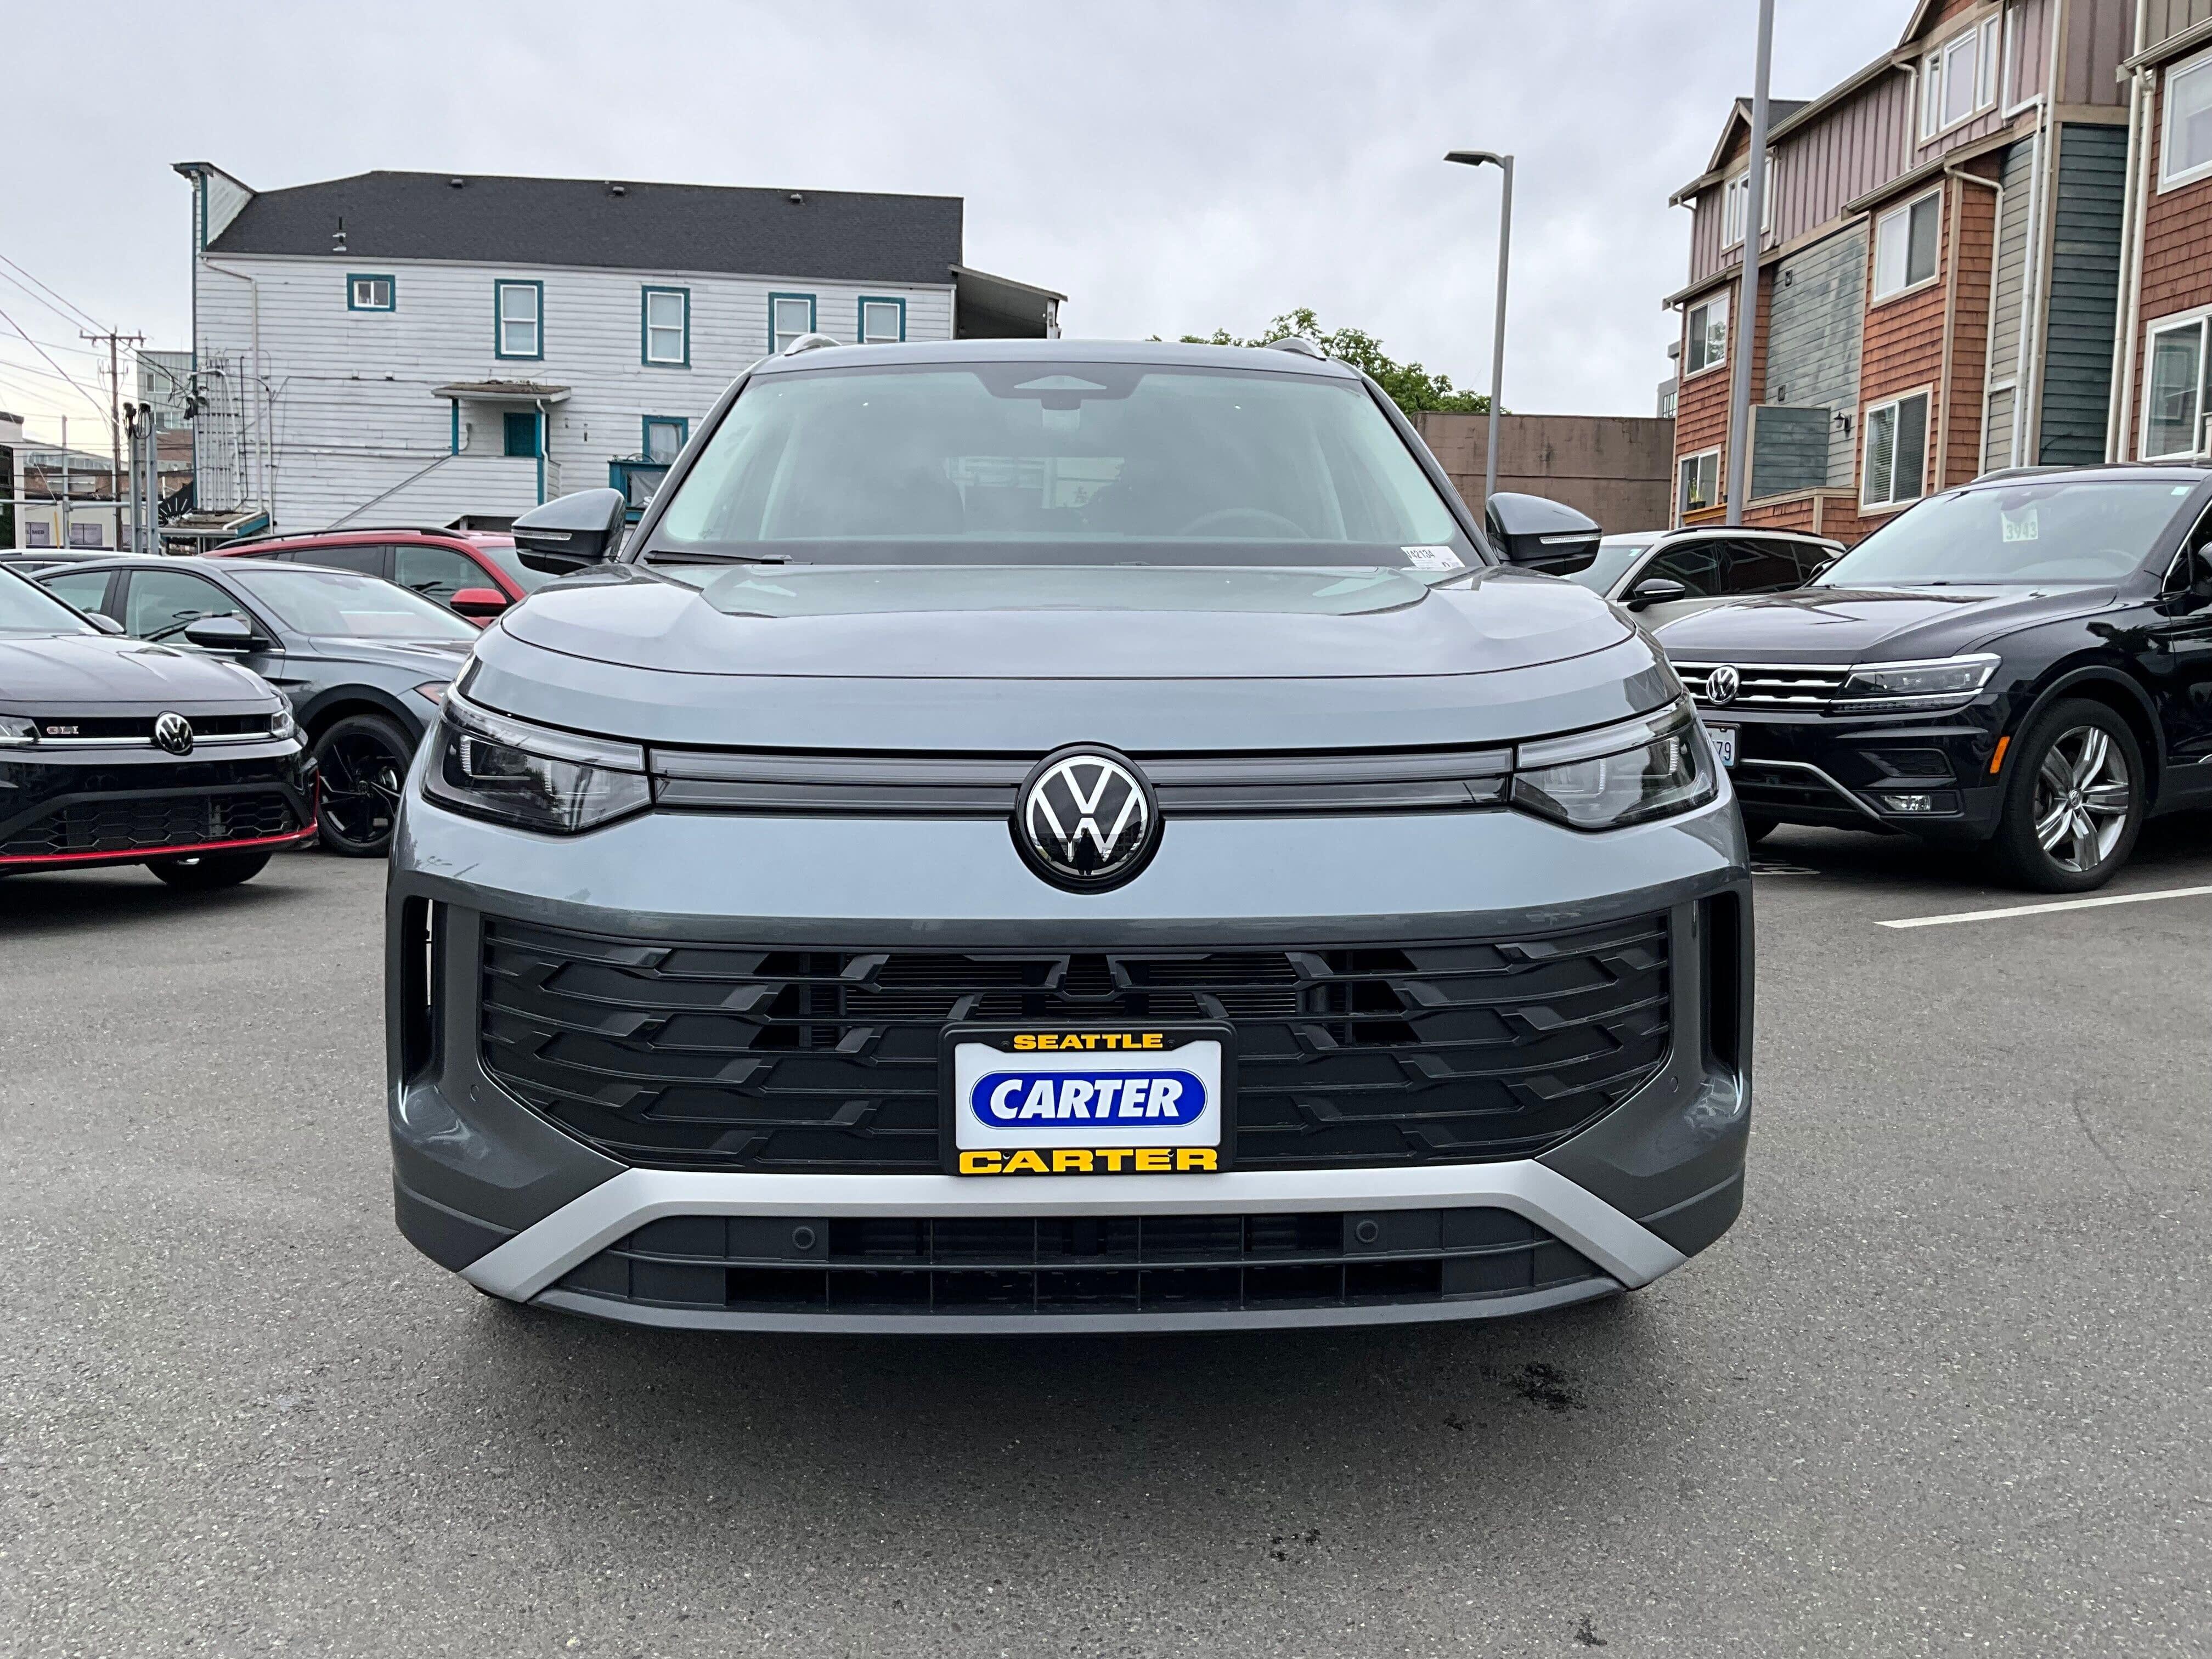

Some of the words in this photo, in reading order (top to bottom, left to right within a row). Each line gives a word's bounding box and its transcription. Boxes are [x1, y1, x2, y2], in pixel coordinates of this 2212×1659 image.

[46, 725, 80, 735] GLI
[156, 713, 193, 753] VW
[1712, 741, 1731, 761] 79
[1026, 755, 1148, 876] VW
[1013, 1034, 1163, 1049] SEATTLE
[989, 1079, 1183, 1120] CARTER
[959, 1148, 1217, 1174] CARTER
